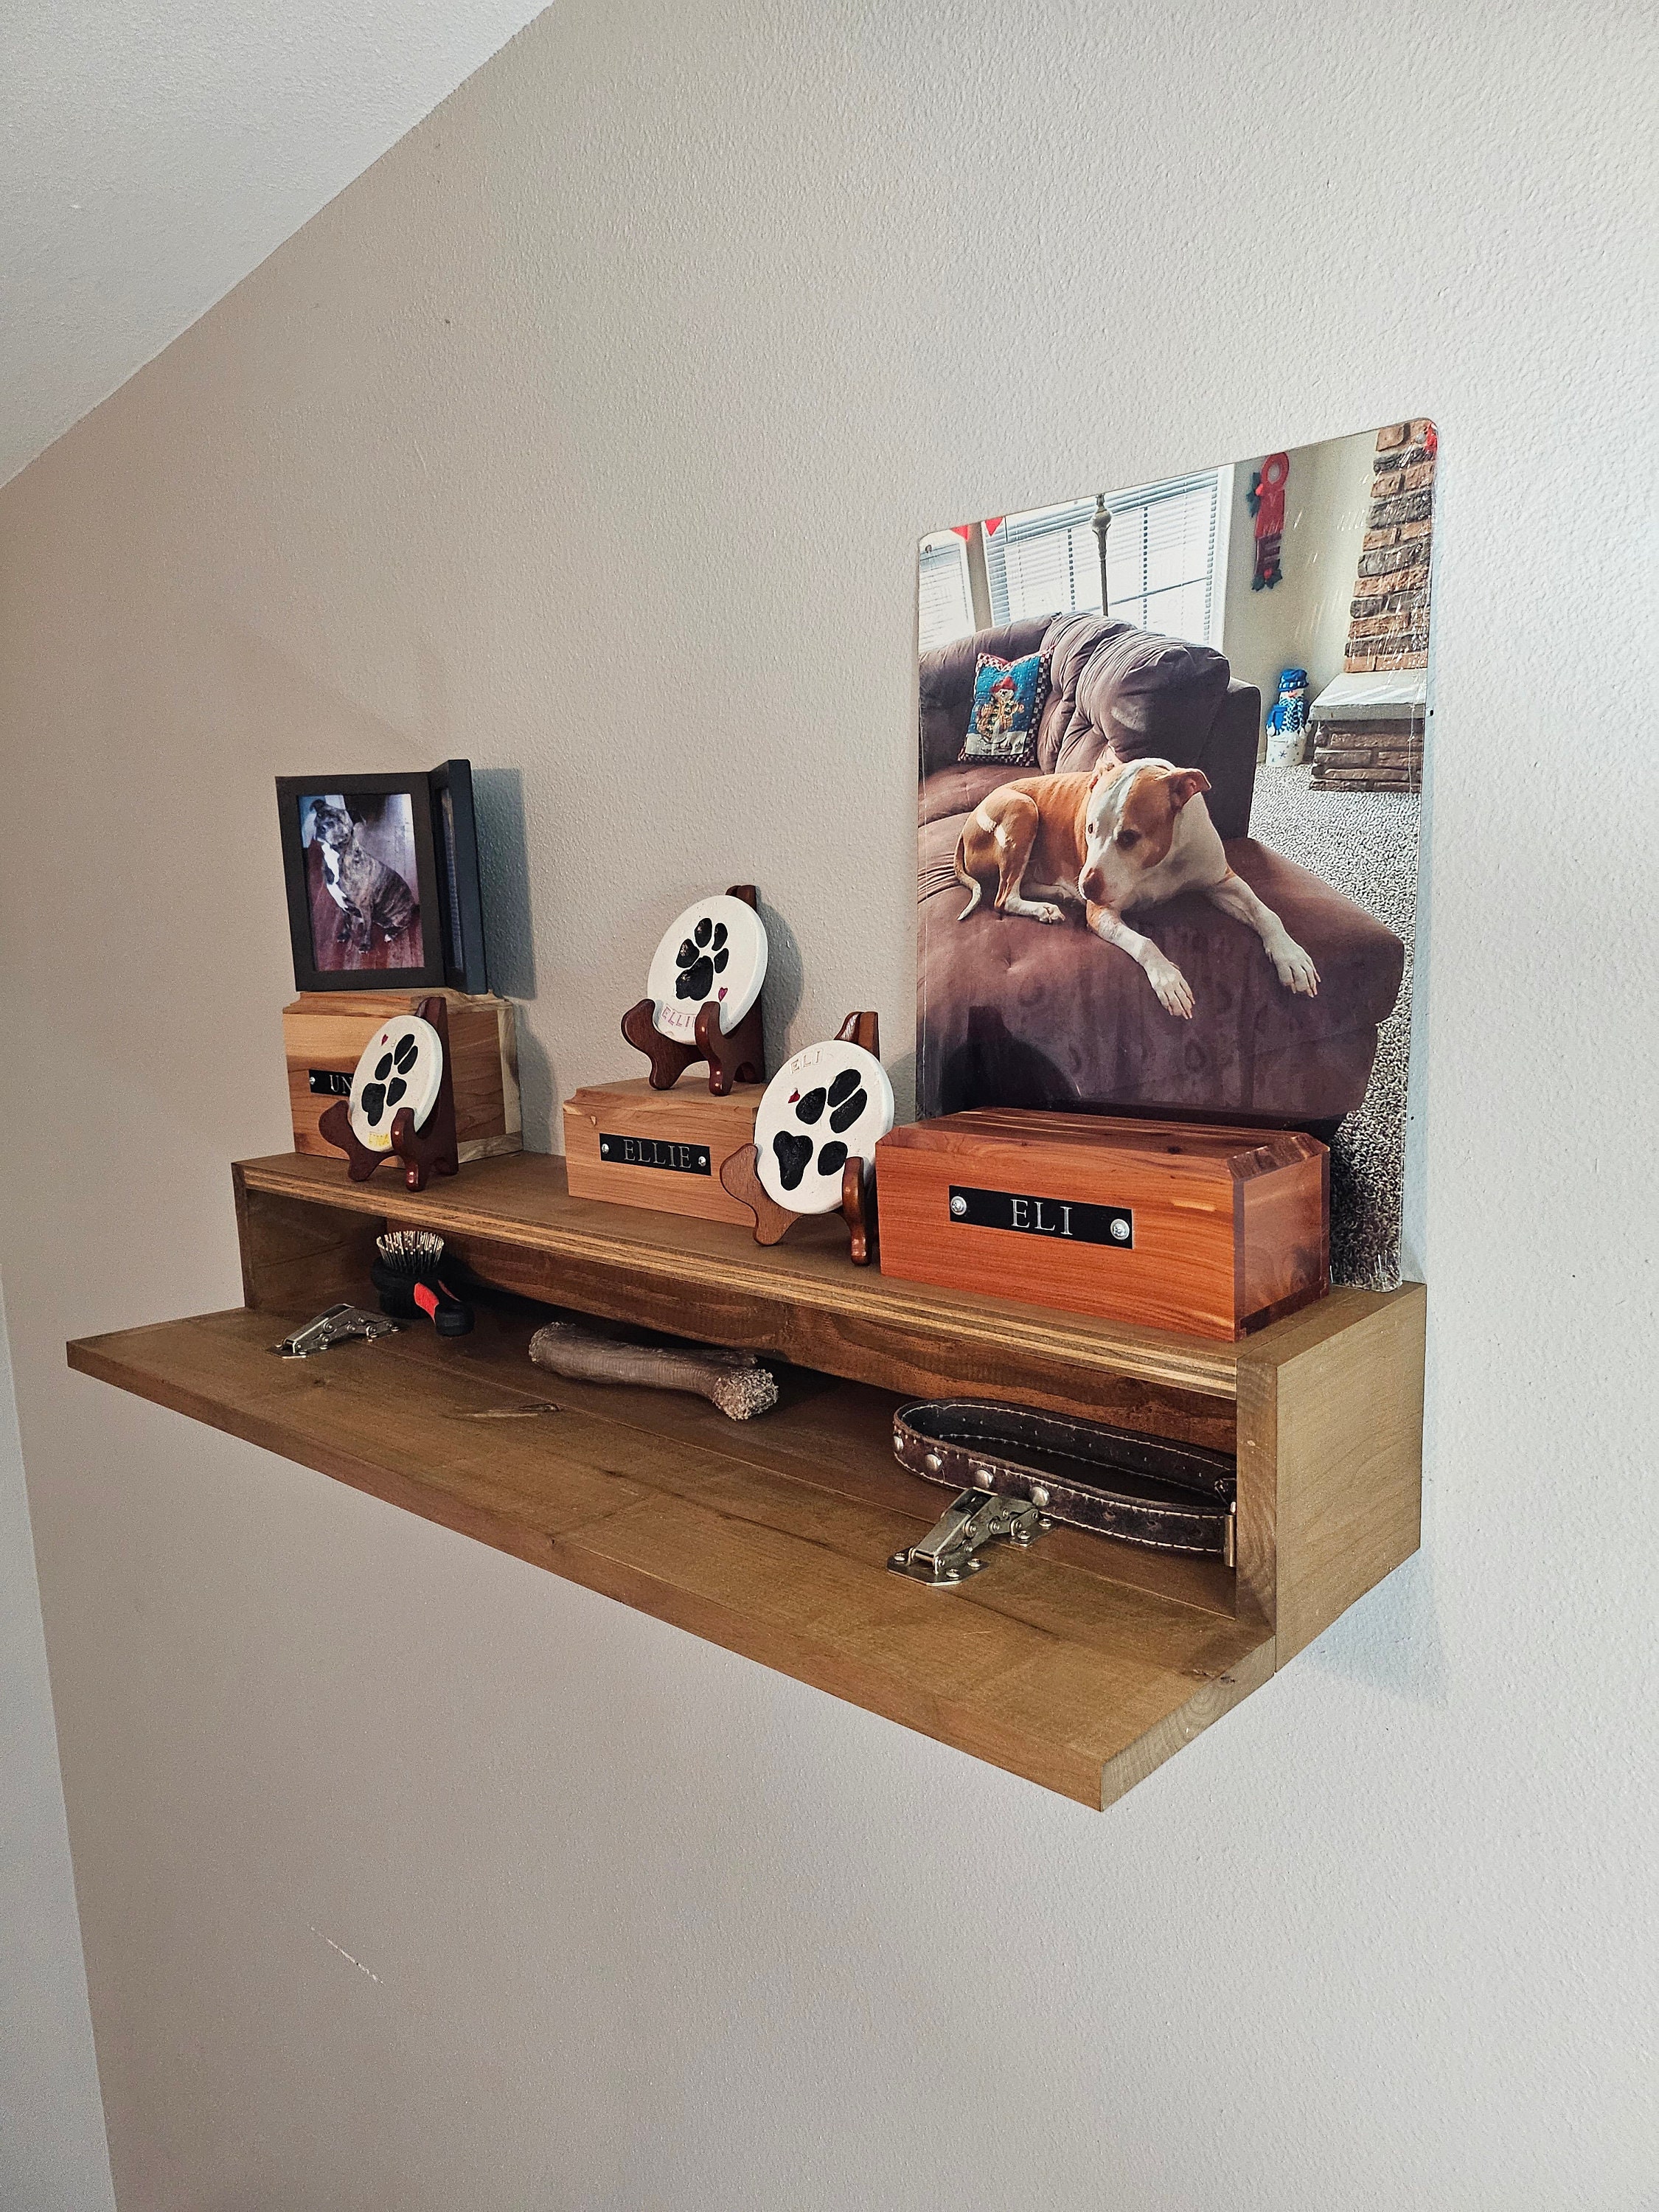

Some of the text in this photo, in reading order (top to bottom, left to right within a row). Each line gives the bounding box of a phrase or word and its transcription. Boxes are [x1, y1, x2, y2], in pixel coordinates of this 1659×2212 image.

[790, 1051, 821, 1074] ELI
[329, 1074, 352, 1094] UN
[623, 1139, 692, 1169] ELLIE
[1010, 1199, 1073, 1235] ELI
